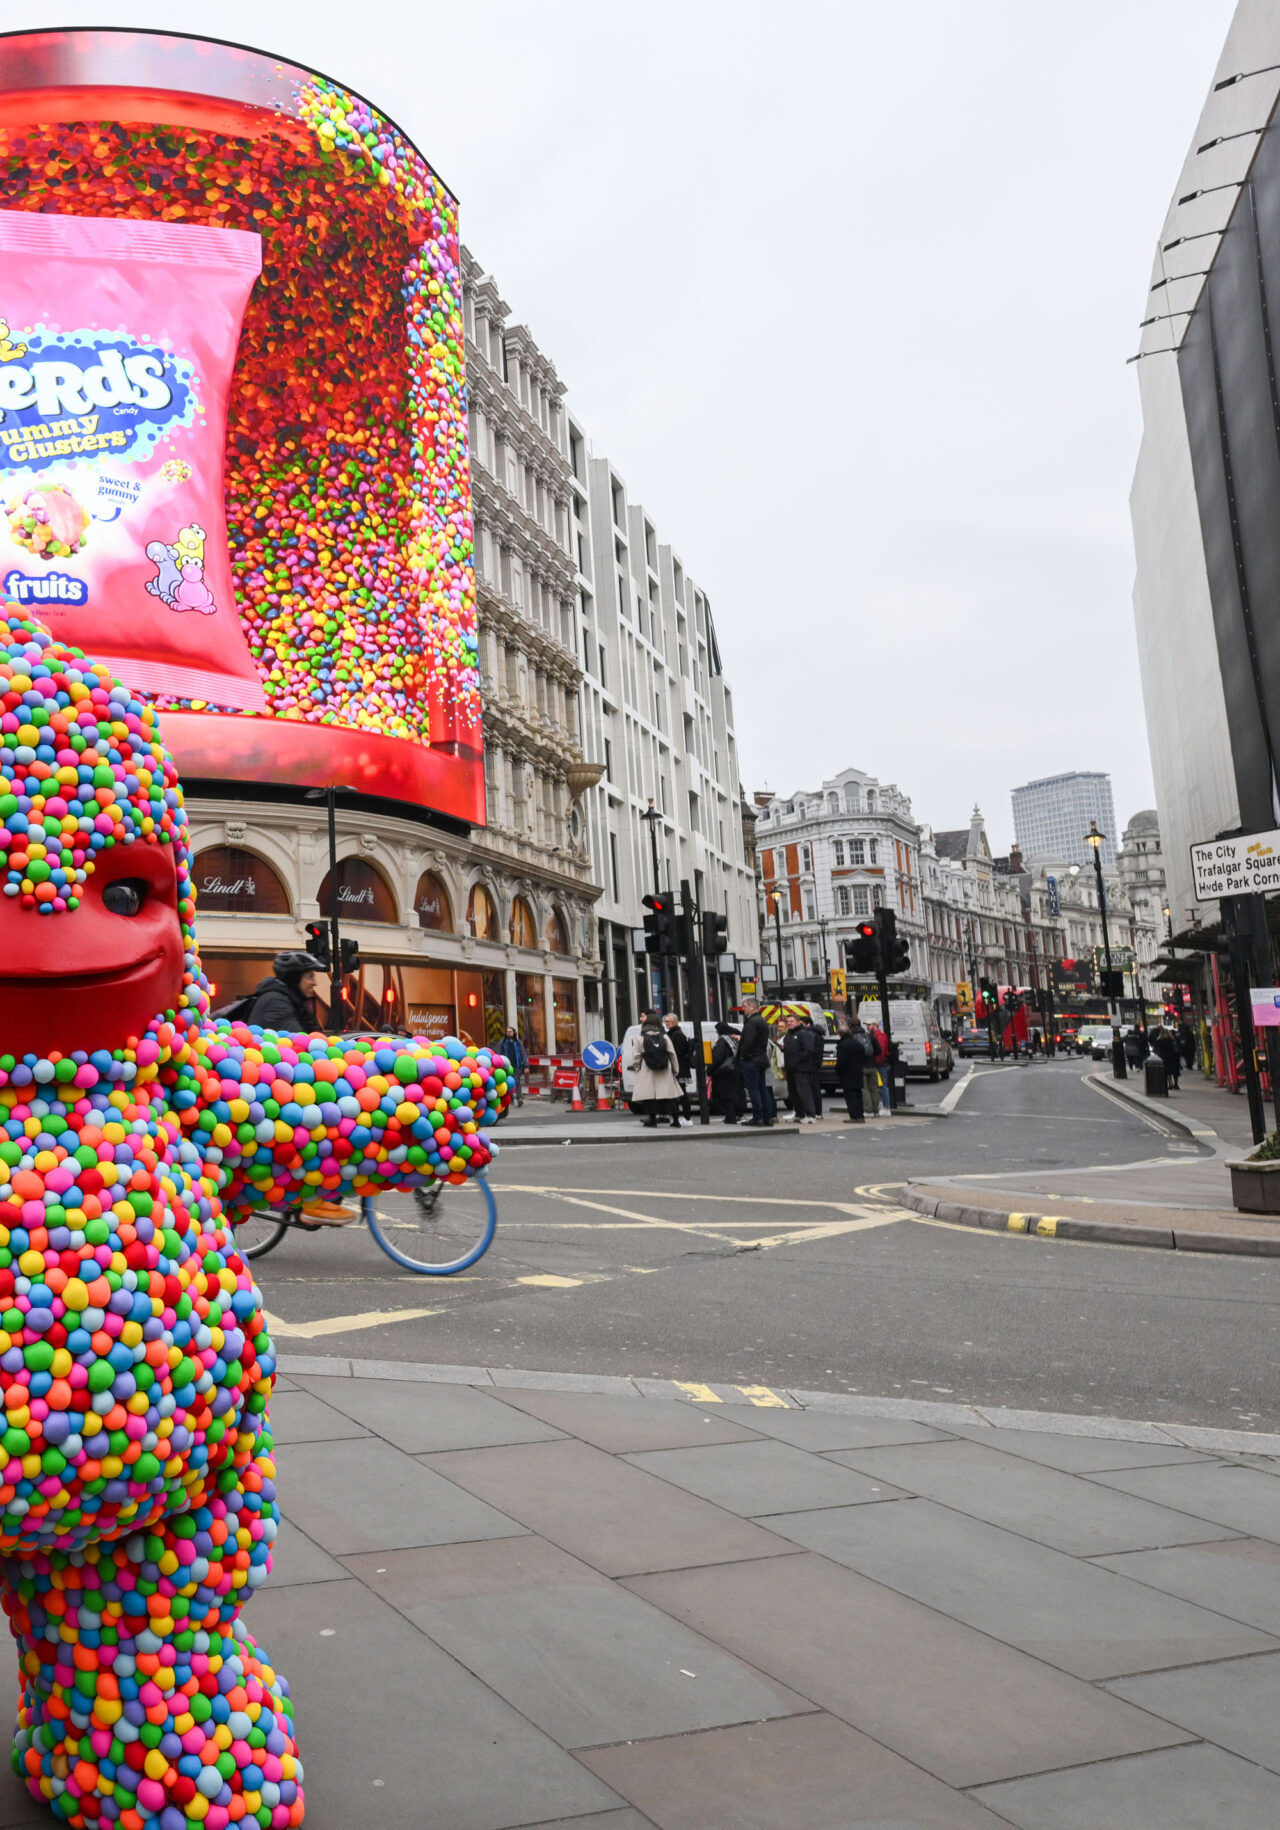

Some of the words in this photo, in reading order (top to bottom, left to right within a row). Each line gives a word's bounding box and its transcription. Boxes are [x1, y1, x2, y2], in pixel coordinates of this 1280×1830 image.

[113, 407, 138, 415] Candy
[99, 475, 130, 489] sweet
[132, 482, 142, 492] &
[97, 486, 139, 504] gummy
[7, 573, 82, 600] fruits
[1195, 849, 1213, 862] The
[1216, 845, 1236, 859] City
[1197, 862, 1241, 878] Trafalgar
[200, 876, 244, 894] Lindt
[1199, 880, 1223, 894] Hyde
[1227, 875, 1250, 890] Park
[1253, 872, 1280, 886] Corn
[337, 885, 366, 904] Lindt
[1049, 883, 1057, 914] LYRIC
[420, 897, 436, 912] Lindt
[408, 1009, 448, 1028] Indulgence
[418, 1027, 427, 1035] the
[427, 1027, 445, 1037] making
